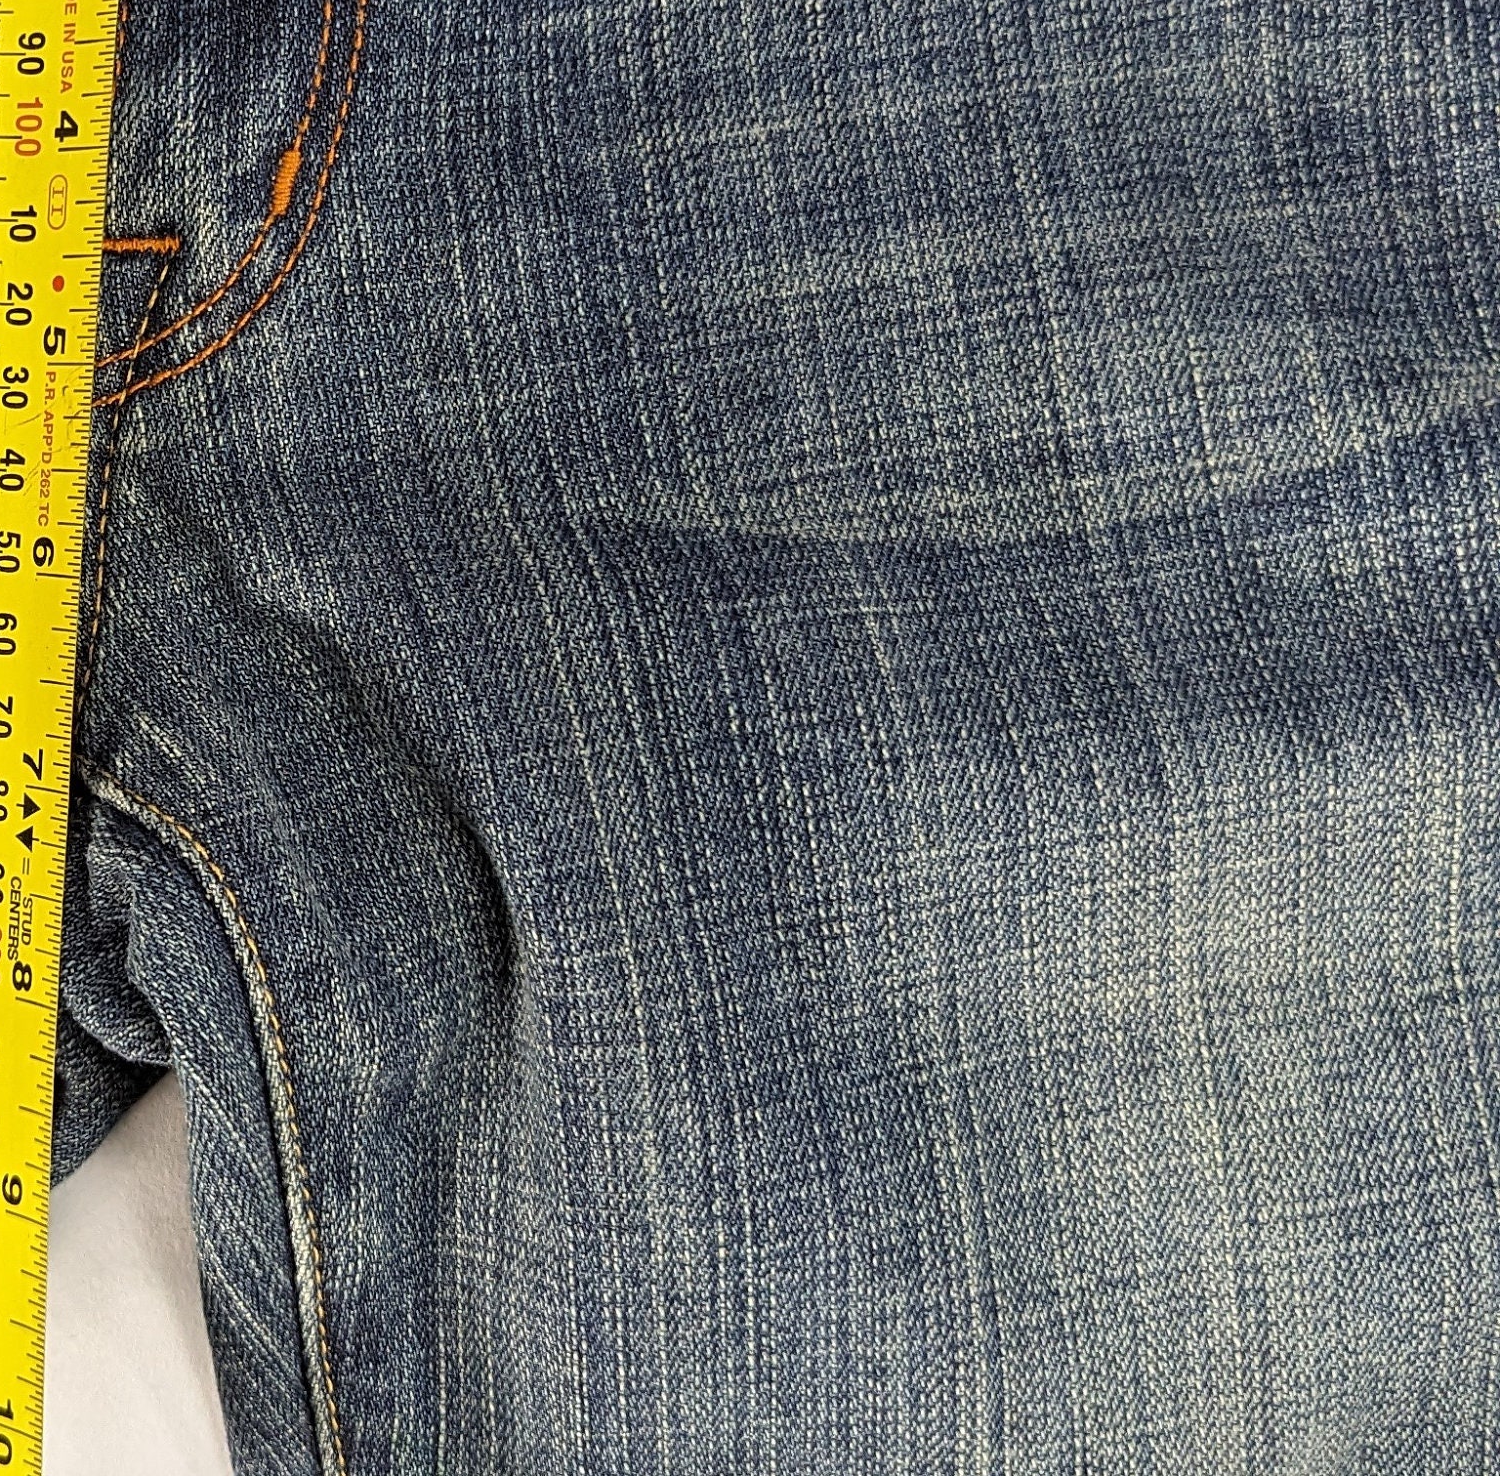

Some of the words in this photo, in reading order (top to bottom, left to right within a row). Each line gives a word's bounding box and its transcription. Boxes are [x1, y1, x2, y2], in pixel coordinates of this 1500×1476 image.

[63, 26, 77, 42] IN
[17, 32, 46, 75] 90
[60, 51, 74, 93] USA
[14, 97, 44, 157] 100
[54, 110, 79, 142] 4
[9, 205, 38, 243] 10
[5, 283, 33, 326] 20
[43, 325, 66, 356] 5
[1, 366, 29, 409] 30
[44, 371, 56, 405] P.R.
[41, 410, 54, 464] APP'D
[39, 469, 51, 498] 262
[37, 502, 50, 527] TC
[33, 536, 55, 567] 6
[22, 748, 44, 781] 7
[7, 876, 22, 961] CENTERS
[21, 896, 33, 946] STUD
[12, 960, 33, 992] 8
[2, 1173, 23, 1206] 9
